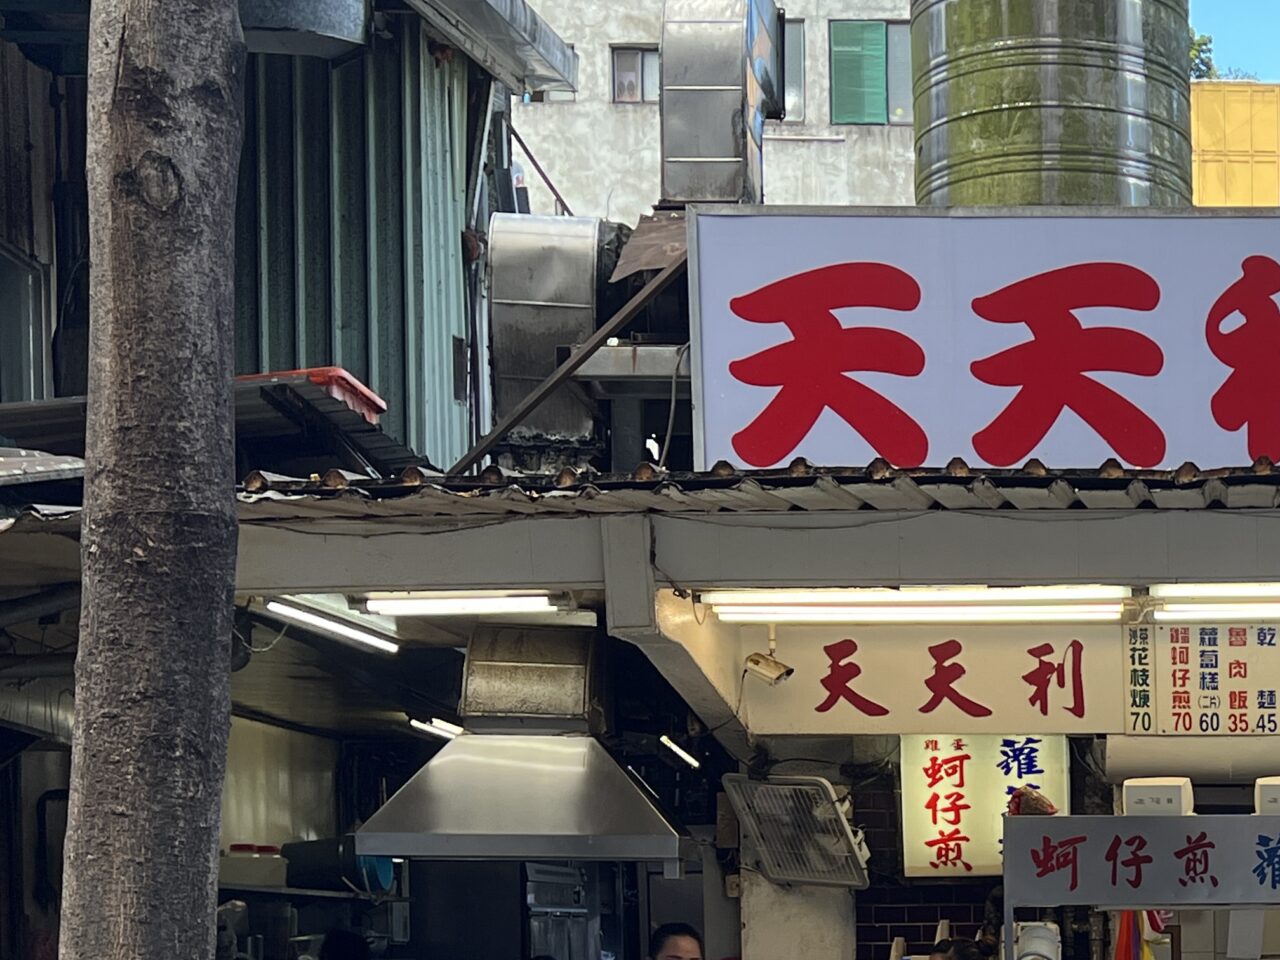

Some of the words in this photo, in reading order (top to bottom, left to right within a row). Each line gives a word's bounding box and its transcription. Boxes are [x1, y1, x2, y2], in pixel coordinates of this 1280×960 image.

[814, 639, 1085, 719] 天天利
[1130, 712, 1151, 731] 70
[1172, 712, 1192, 732] 70
[1199, 712, 1220, 732] 60
[1228, 713, 1249, 733] 35
[1256, 713, 1277, 733] 45
[923, 753, 973, 872] 蚵仔煎
[1031, 831, 1219, 892] 蚵仔煎
